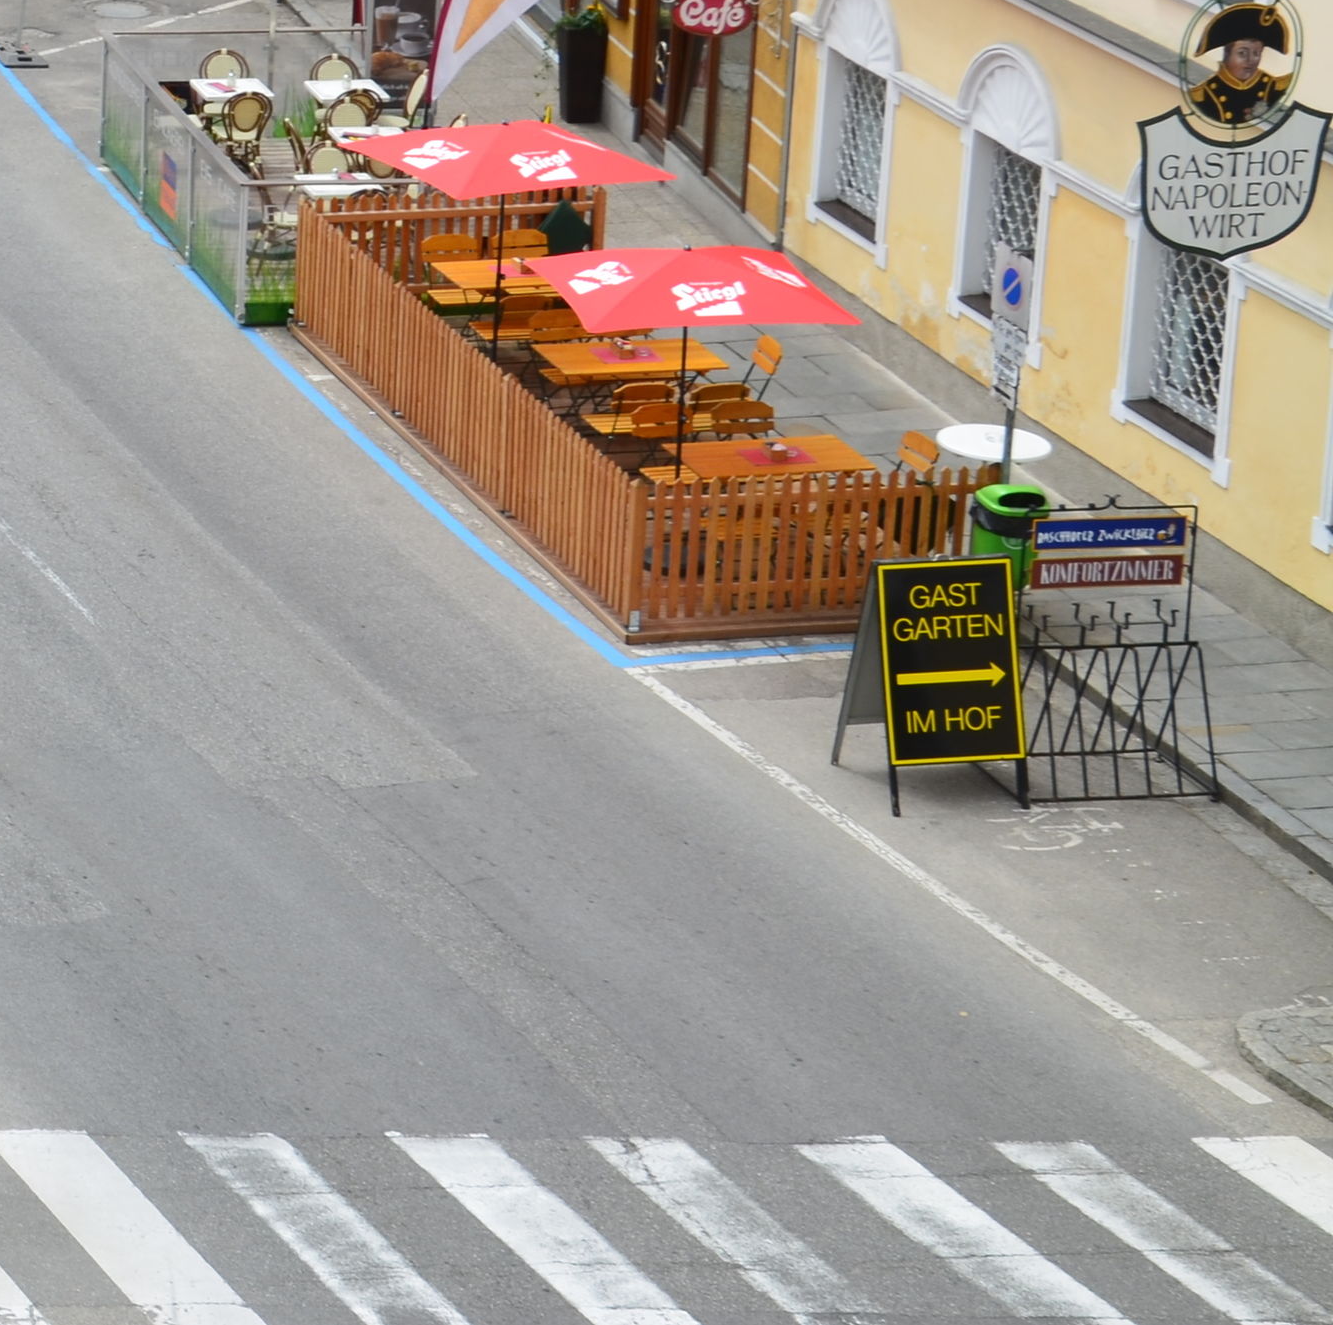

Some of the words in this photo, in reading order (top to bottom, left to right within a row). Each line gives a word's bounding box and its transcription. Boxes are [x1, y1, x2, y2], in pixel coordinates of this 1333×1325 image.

[509, 149, 572, 178] Stiegl
[1158, 148, 1309, 181] GASTHOF
[1151, 180, 1308, 211] NAPOLEON-
[1188, 211, 1265, 239] WIRT
[670, 281, 747, 311] Stiegl
[1040, 559, 1174, 585] KOMFORTZIMMER
[908, 582, 982, 609] GAST
[893, 613, 1004, 643] GARTEN
[906, 707, 936, 734] IM
[944, 705, 1002, 732] HOF
